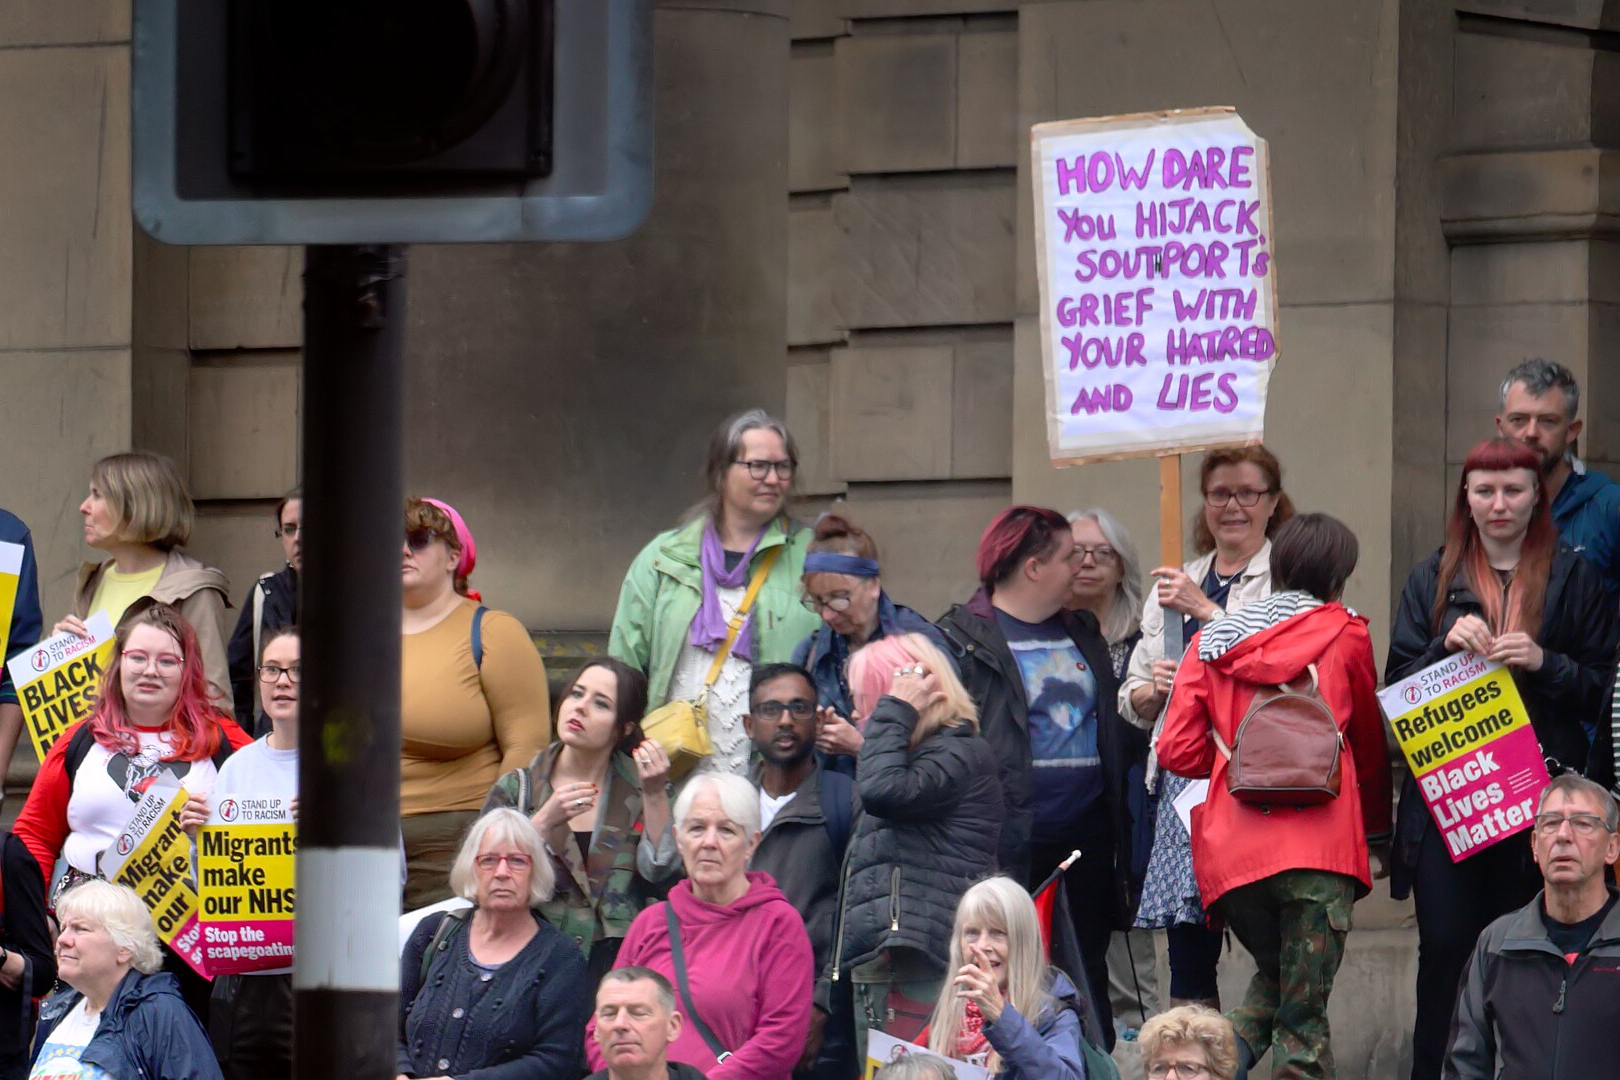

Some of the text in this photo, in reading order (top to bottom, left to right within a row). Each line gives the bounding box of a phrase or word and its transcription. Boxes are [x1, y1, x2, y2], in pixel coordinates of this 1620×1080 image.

[1056, 145, 1254, 196] HOW DARE
[1135, 197, 1260, 239] HIJACK
[1057, 288, 1257, 328] GRIEF WITH
[1061, 326, 1276, 371] YOUR HATRED
[1071, 372, 1239, 415] AND LIES
[52, 635, 97, 662] TO RACISM
[1420, 652, 1476, 686] STAND UP
[23, 652, 104, 712] BLACK
[1425, 685, 1442, 697] TO
[1443, 661, 1487, 689] RACISM
[31, 685, 100, 738] LIVES
[1395, 680, 1502, 742] Refugees
[1411, 708, 1513, 768] welcome
[1420, 750, 1500, 802] Black
[129, 794, 156, 833] STAND UP
[135, 798, 167, 839] TO RACISM
[242, 799, 281, 810] STAND UP
[242, 809, 286, 820] TO RACISM
[1433, 782, 1505, 830] Lives
[1446, 797, 1534, 856] Matter
[117, 810, 182, 891] Migrant
[203, 862, 265, 887] make
[157, 890, 190, 933] our
[204, 888, 296, 914] our NHS
[177, 922, 200, 953] Sto
[205, 926, 265, 945] Stop the
